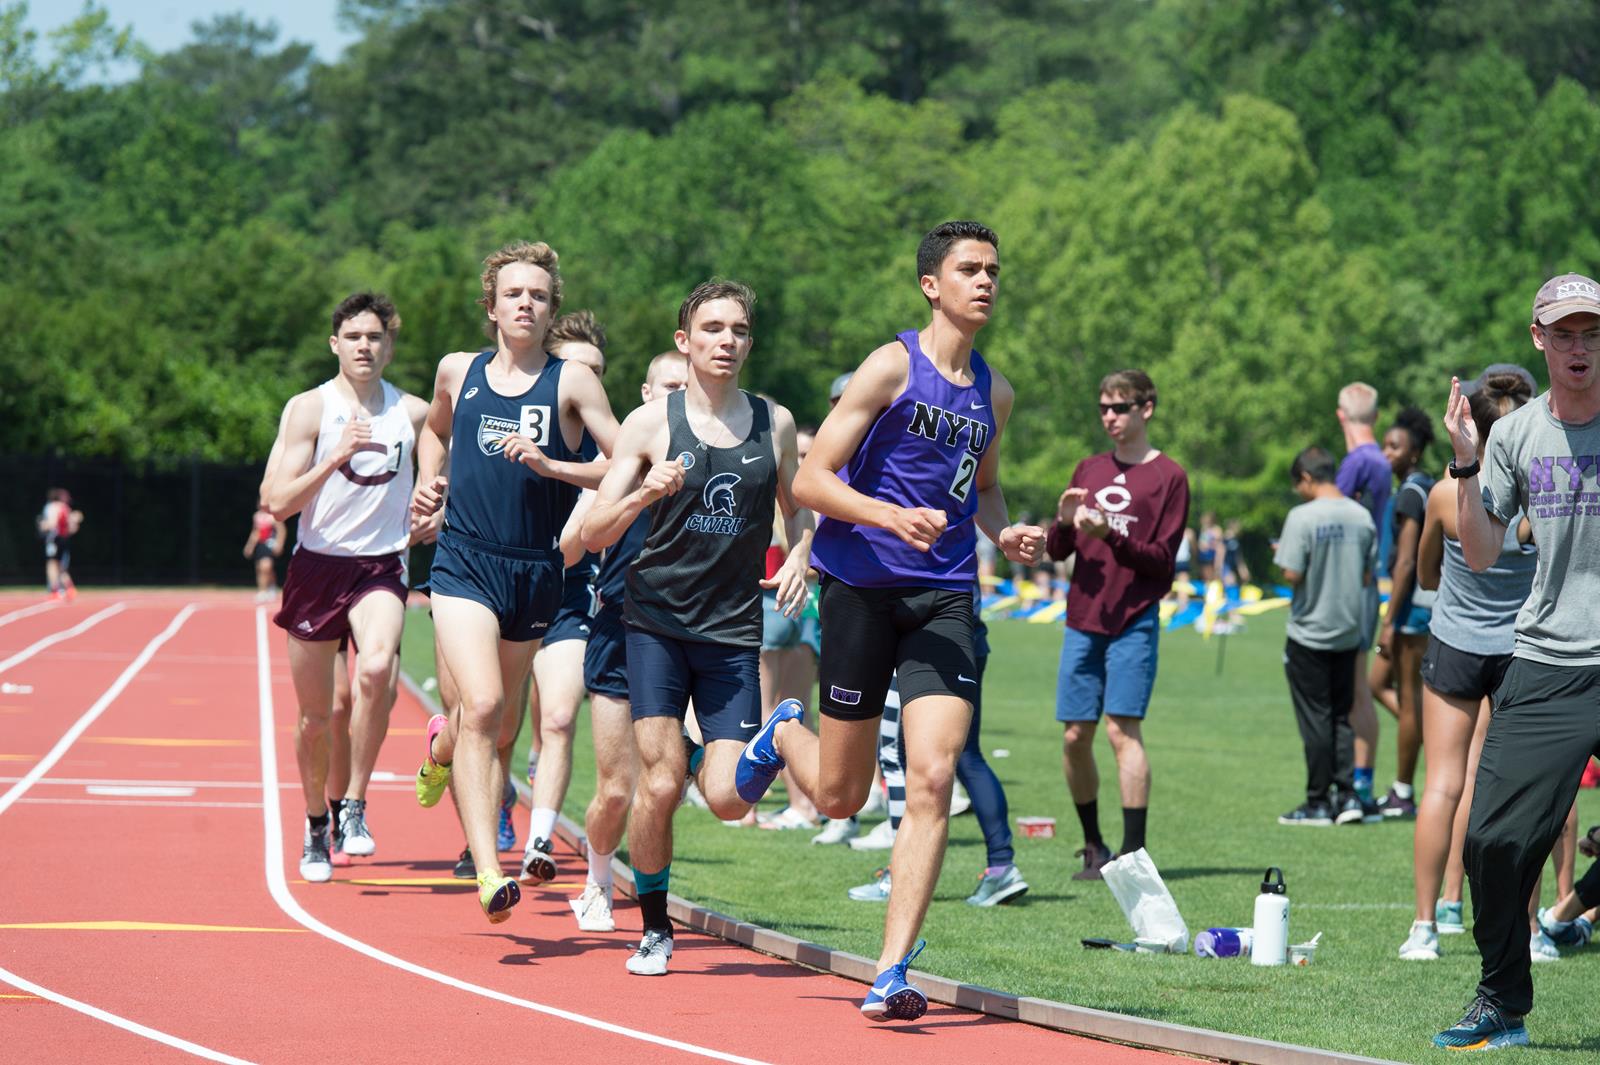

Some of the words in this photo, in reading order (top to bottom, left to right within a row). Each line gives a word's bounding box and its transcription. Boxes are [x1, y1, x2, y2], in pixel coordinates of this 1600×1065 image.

[1556, 282, 1596, 295] NYU
[486, 419, 520, 431] EMORY
[528, 408, 544, 443] 3
[907, 401, 989, 455] NYU
[338, 442, 398, 486] C
[395, 441, 402, 469] 1
[953, 459, 974, 499] 2
[1530, 456, 1600, 493] NY
[1094, 485, 1132, 512] C
[685, 514, 747, 535] CWRU
[831, 686, 861, 704] NYU
